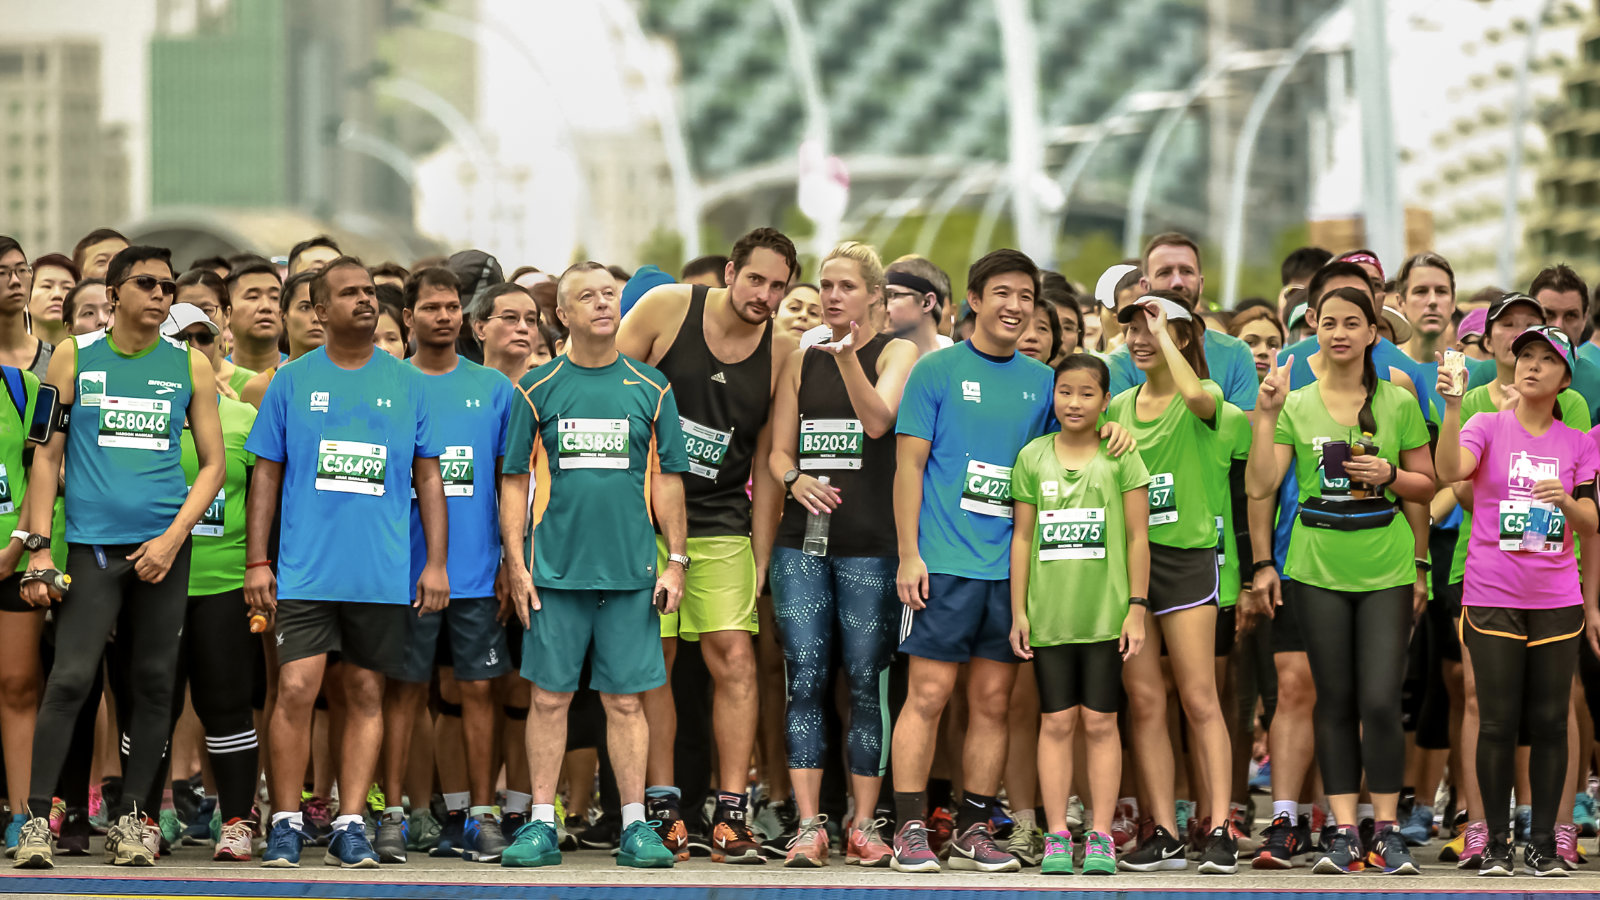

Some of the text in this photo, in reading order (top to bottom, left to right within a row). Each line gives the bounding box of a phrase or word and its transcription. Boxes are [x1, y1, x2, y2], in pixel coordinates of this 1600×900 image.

[104, 411, 165, 431] C58046
[563, 433, 623, 451] C53868
[683, 434, 721, 461] 8386
[804, 435, 857, 451] B52034
[322, 454, 382, 476] C56499
[440, 462, 469, 478] 757
[969, 476, 1010, 499] C4275
[1148, 489, 1170, 506] 57
[1043, 524, 1100, 542] C42375
